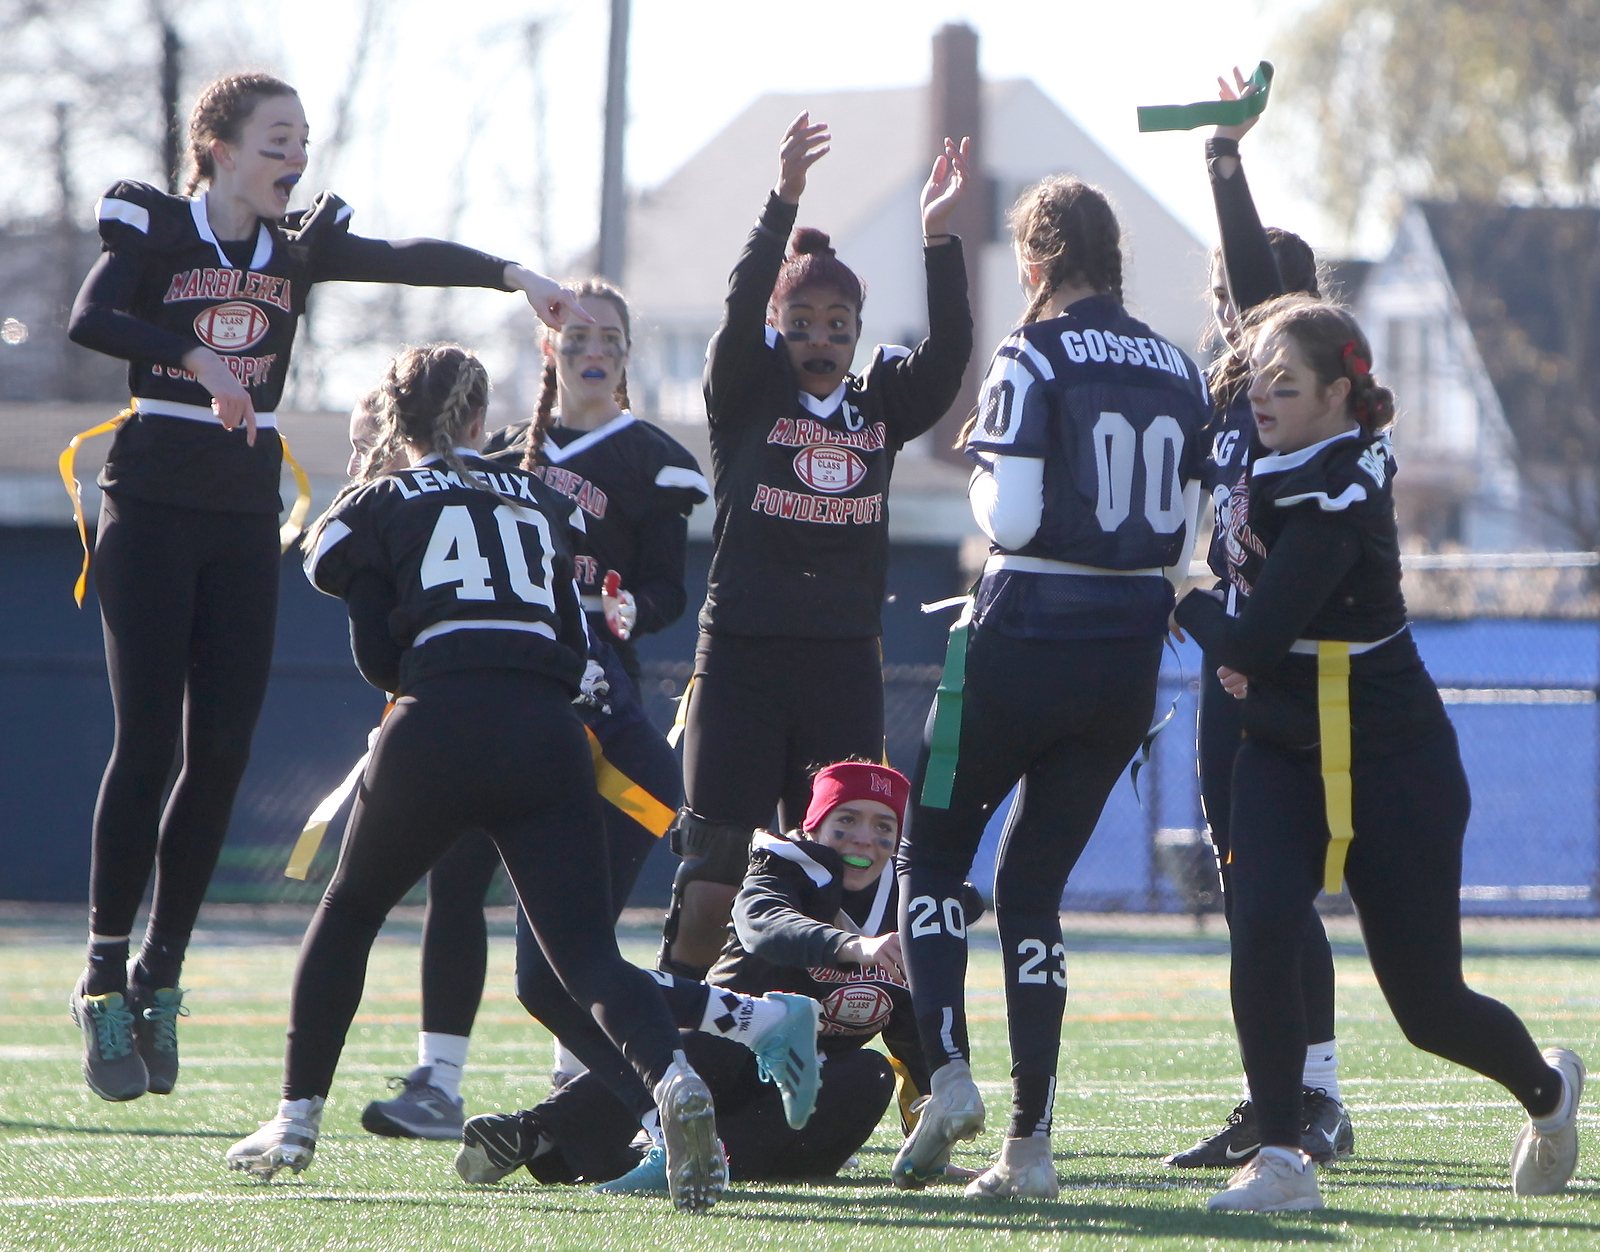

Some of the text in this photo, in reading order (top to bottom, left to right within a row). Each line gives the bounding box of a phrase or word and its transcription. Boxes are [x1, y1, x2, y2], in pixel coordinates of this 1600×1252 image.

[220, 316, 244, 325] CLASS
[1060, 329, 1190, 380] GOSSELIN
[841, 400, 864, 430] C
[817, 459, 841, 471] CLASS
[1092, 411, 1186, 534] 00
[751, 483, 883, 525] POWDERPUFF
[420, 504, 557, 614] 40
[870, 772, 892, 796] M
[908, 895, 967, 940] 20
[1017, 938, 1067, 989] 23
[847, 1001, 870, 1009] CLASS
